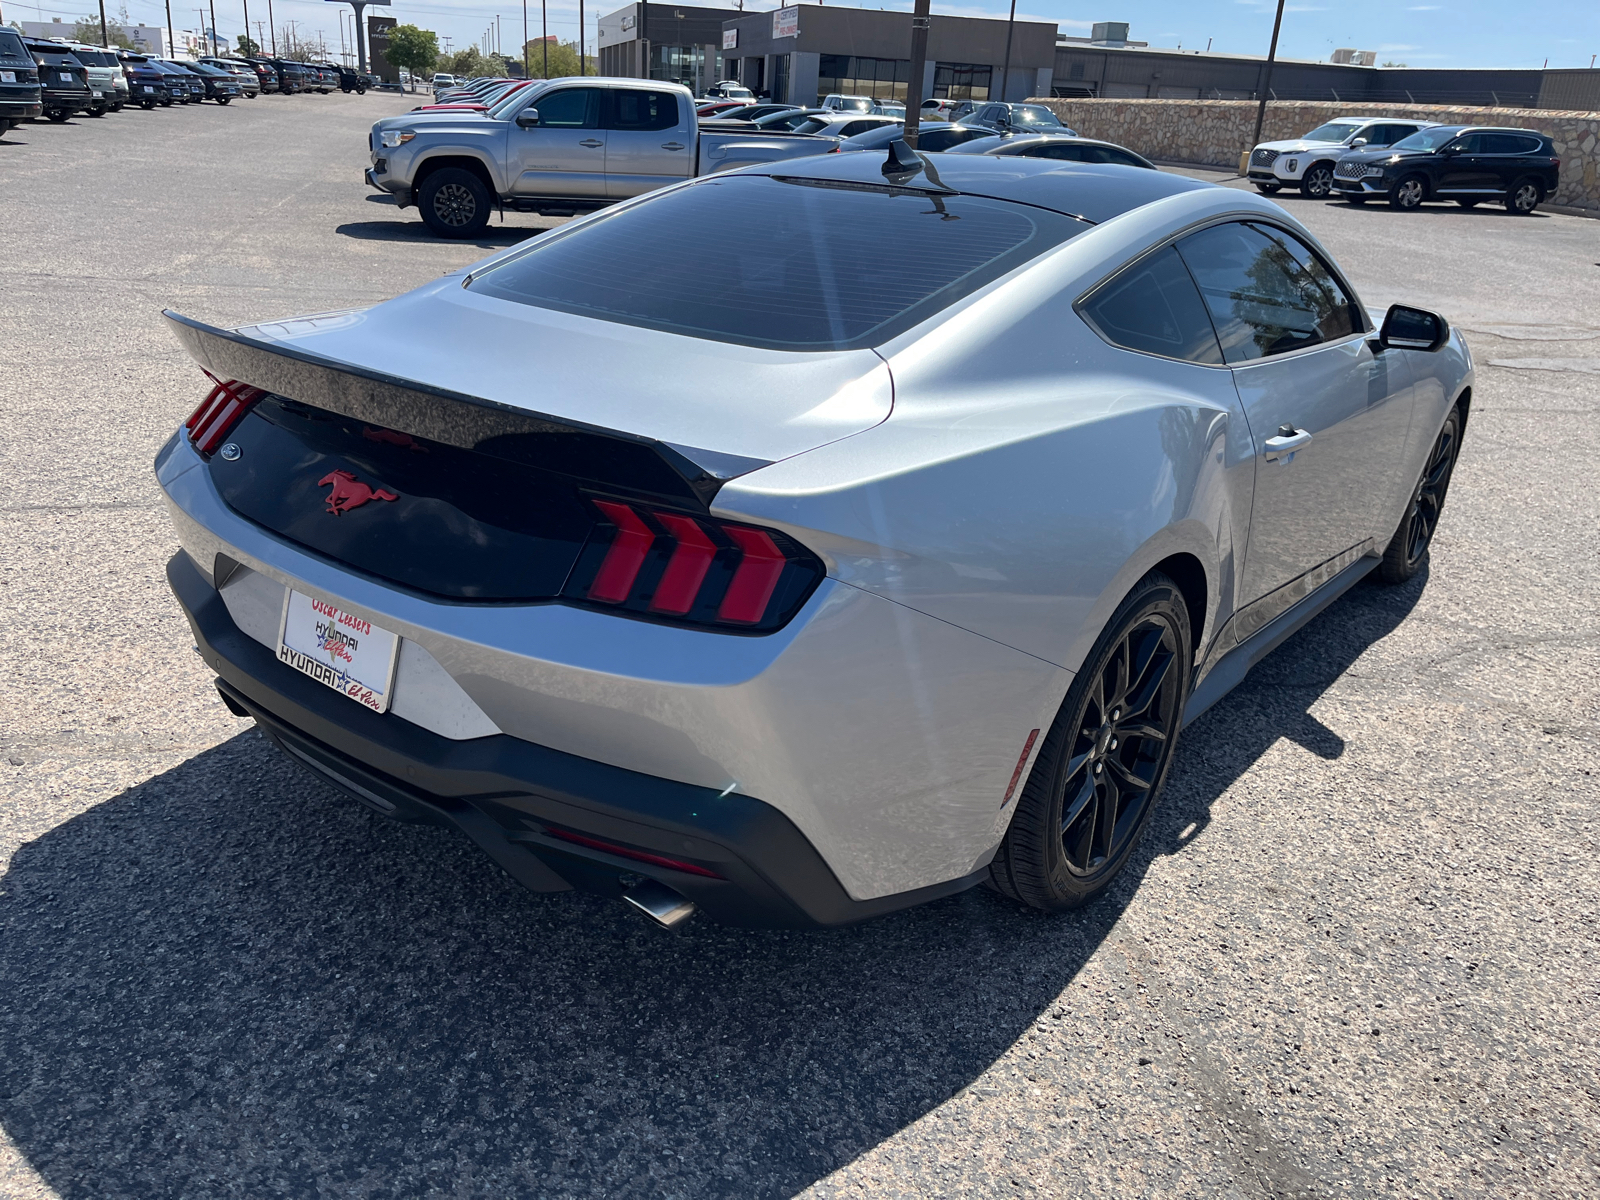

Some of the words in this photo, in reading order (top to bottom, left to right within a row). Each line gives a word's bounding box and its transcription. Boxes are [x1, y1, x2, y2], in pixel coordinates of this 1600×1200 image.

[312, 598, 338, 619] Oscar
[315, 621, 359, 651] HYUNDAI
[324, 639, 339, 651] El
[334, 642, 353, 663] Paso
[280, 646, 337, 686] HYUNDAI
[348, 684, 361, 696] El
[360, 690, 381, 711] Paso
